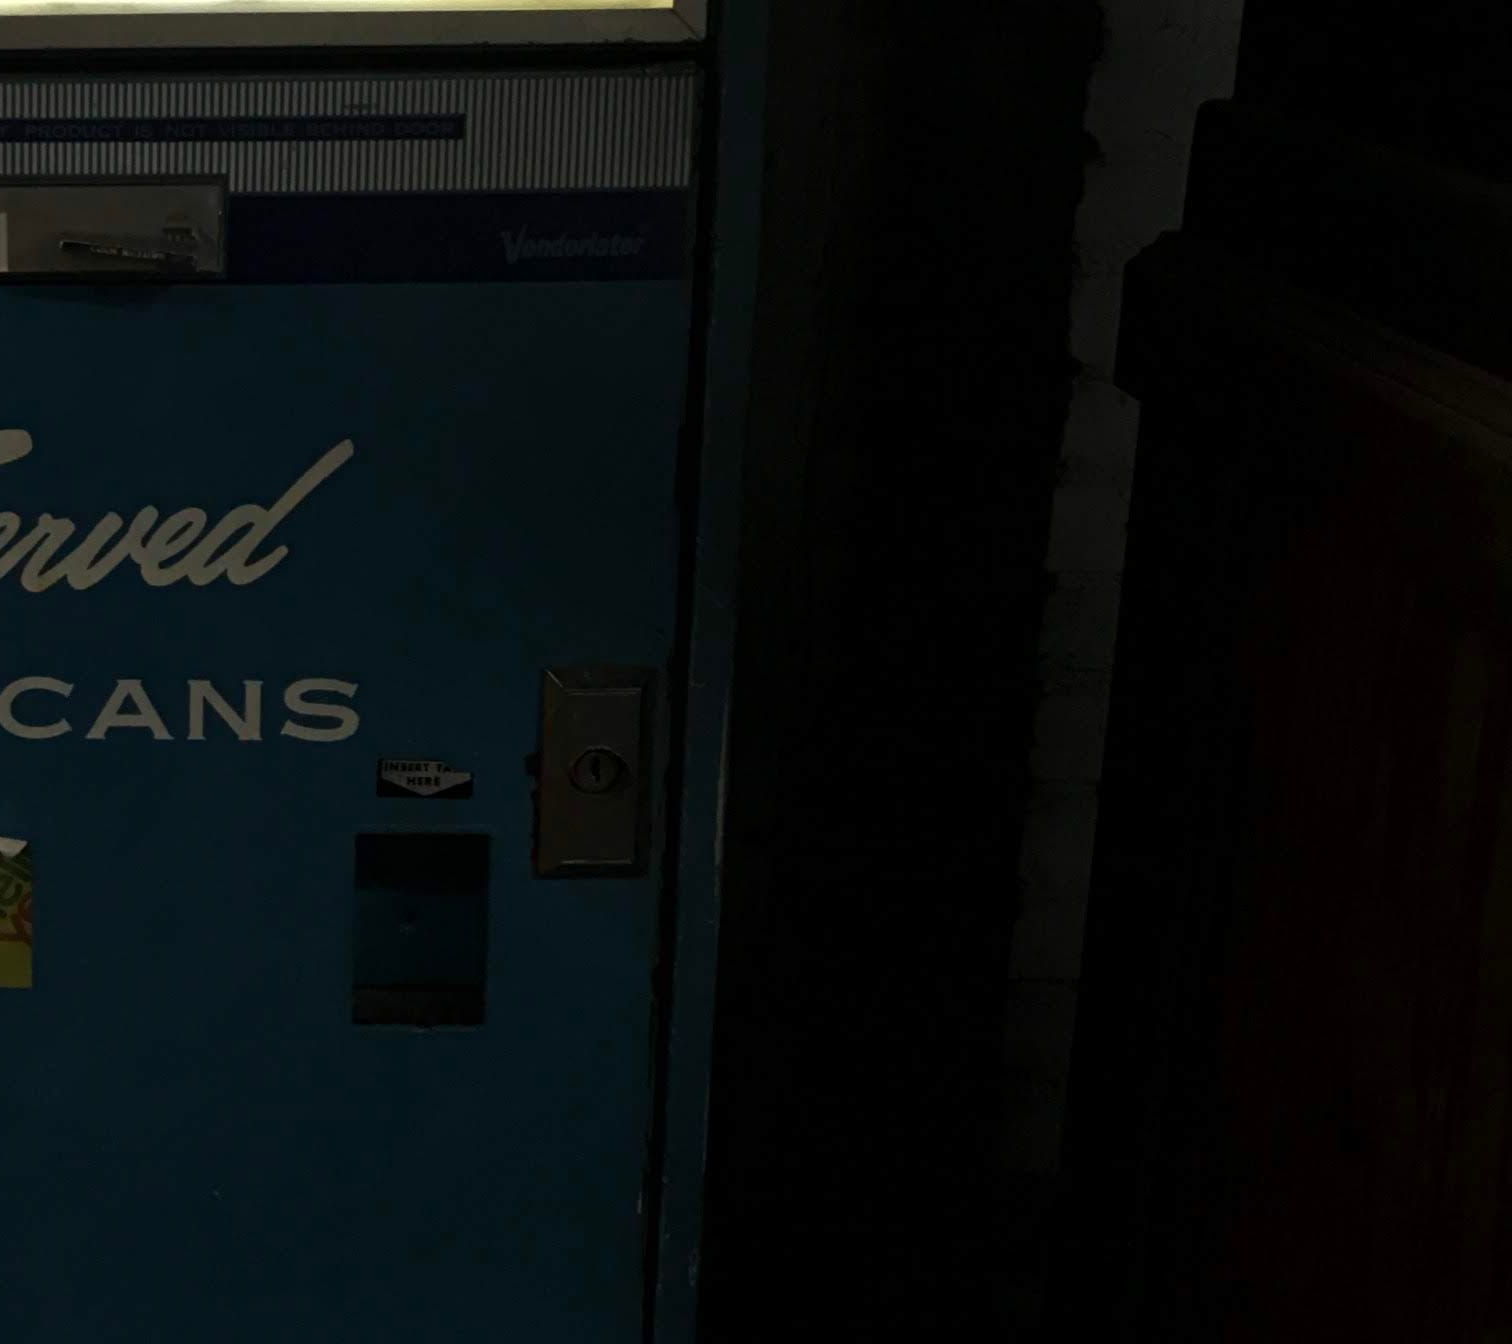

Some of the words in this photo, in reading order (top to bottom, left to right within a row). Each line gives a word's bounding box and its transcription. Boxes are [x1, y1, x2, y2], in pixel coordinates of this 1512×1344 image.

[26, 124, 122, 139] PRODUCT
[165, 124, 208, 138] NOT
[383, 762, 430, 772] INSERT
[406, 776, 441, 786] HERE
